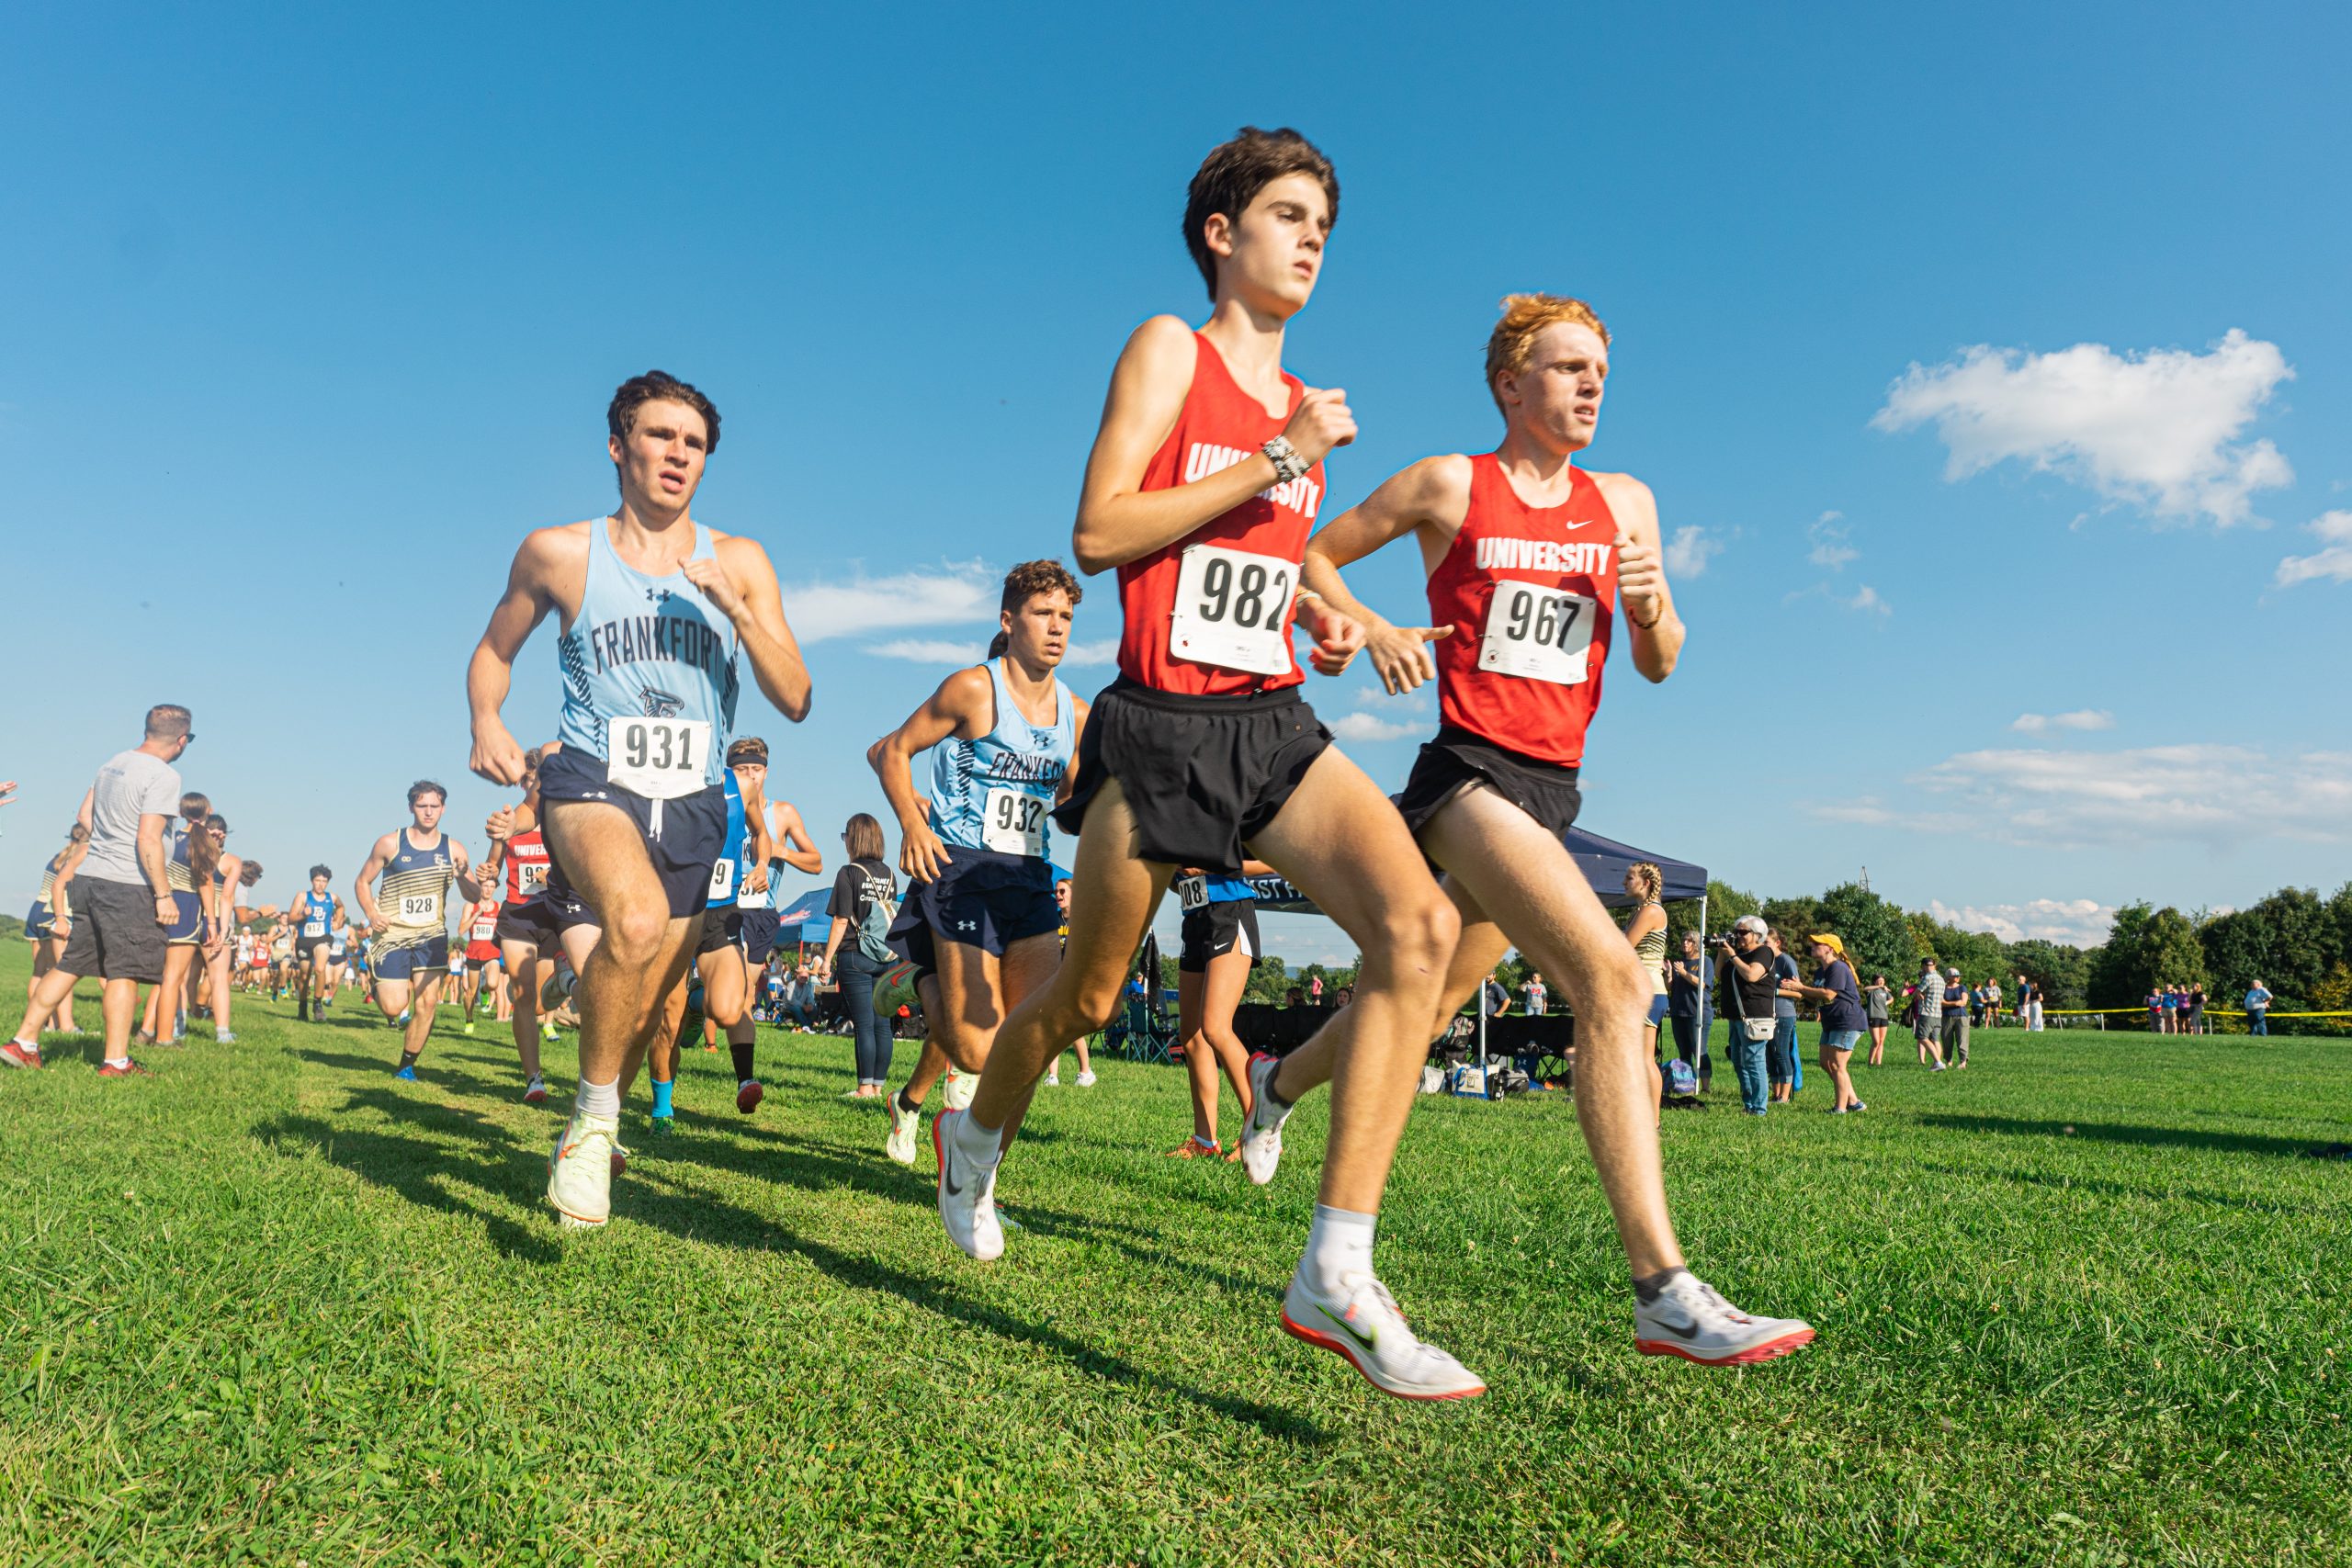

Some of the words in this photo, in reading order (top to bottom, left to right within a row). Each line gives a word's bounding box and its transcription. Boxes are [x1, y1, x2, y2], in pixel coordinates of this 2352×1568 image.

[1476, 536, 1611, 576] UNIVERSITY
[1507, 590, 1581, 649] 967
[591, 615, 722, 679] FRANKFORT
[625, 724, 693, 771] 931
[996, 795, 1044, 834] 932
[405, 897, 433, 915] 928
[475, 925, 492, 935] 980
